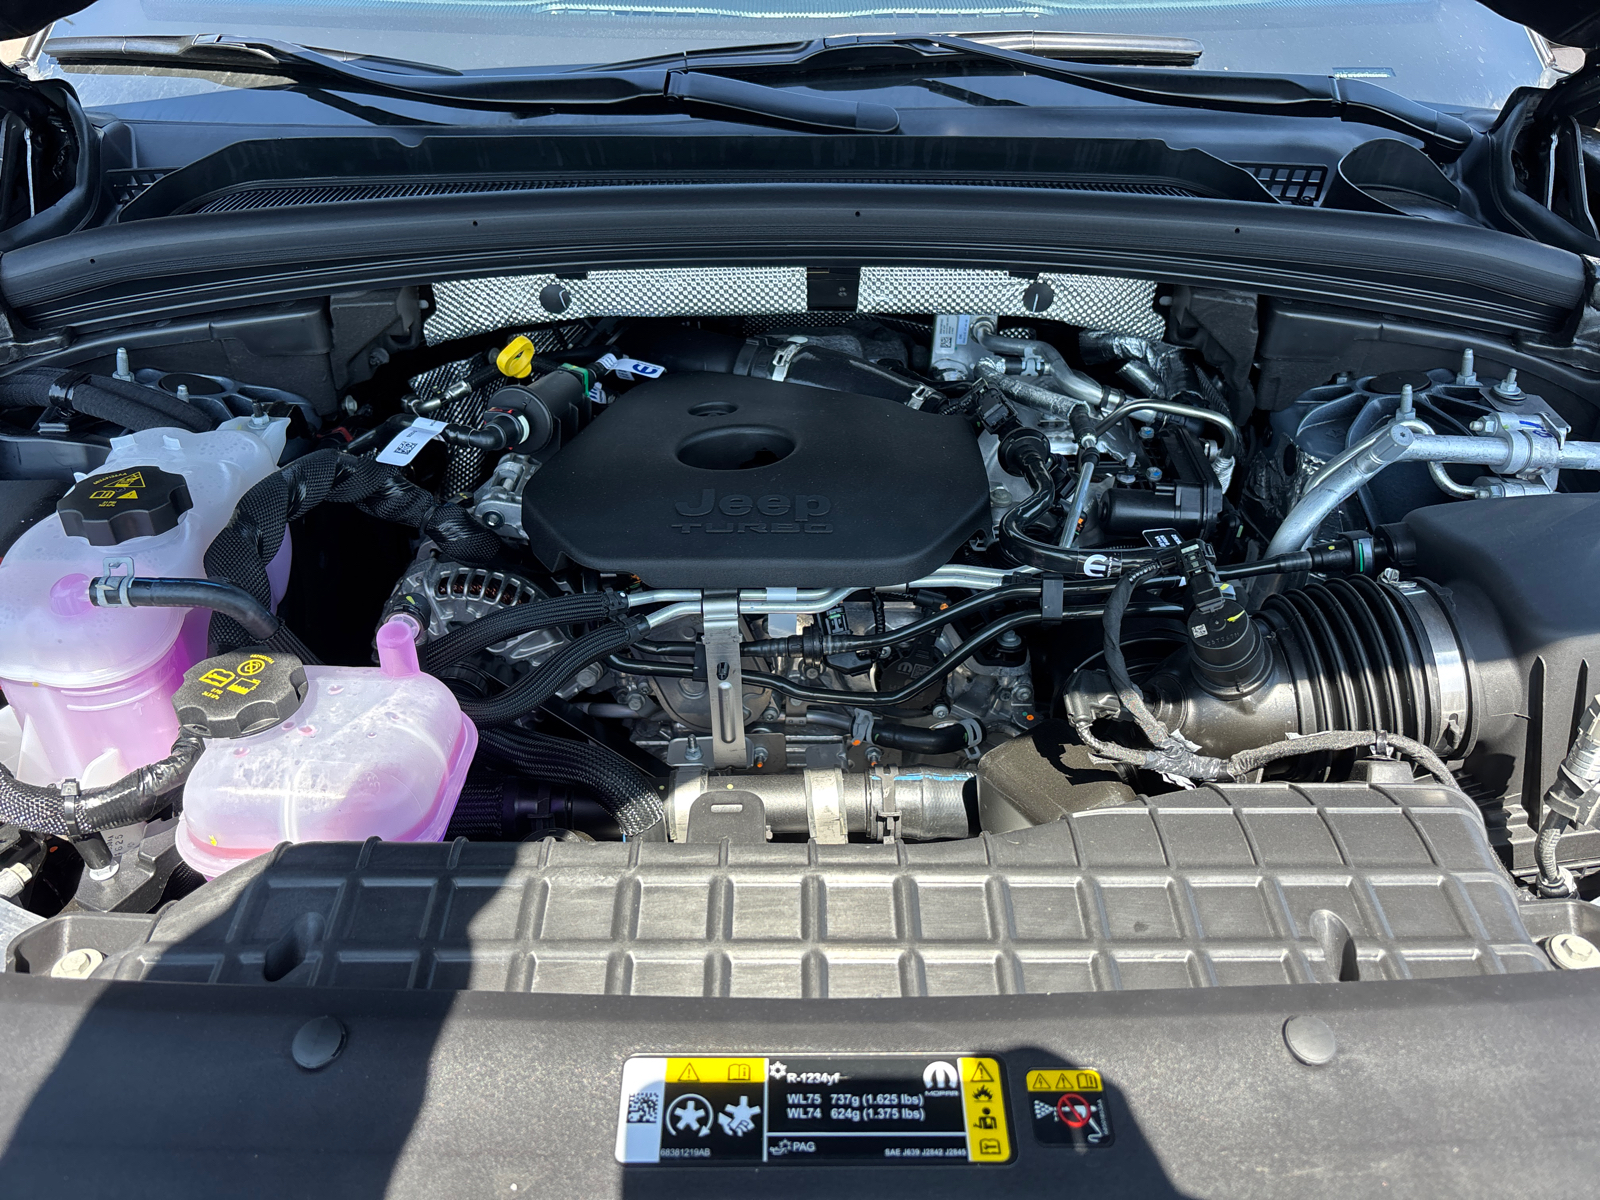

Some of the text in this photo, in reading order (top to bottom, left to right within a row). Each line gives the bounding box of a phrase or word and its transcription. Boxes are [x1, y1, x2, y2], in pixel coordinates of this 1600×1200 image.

[674, 488, 832, 523] Jeep
[671, 522, 834, 535] TURBO
[786, 1072, 841, 1086] R-1234yf
[786, 1093, 924, 1107] WL75 737g (1.625 lbs)
[786, 1107, 926, 1122] WL74 624g (1.375 lbs)
[660, 1148, 711, 1157] 68381219AB
[793, 1141, 816, 1152] PAG
[885, 1147, 901, 1157] SAE
